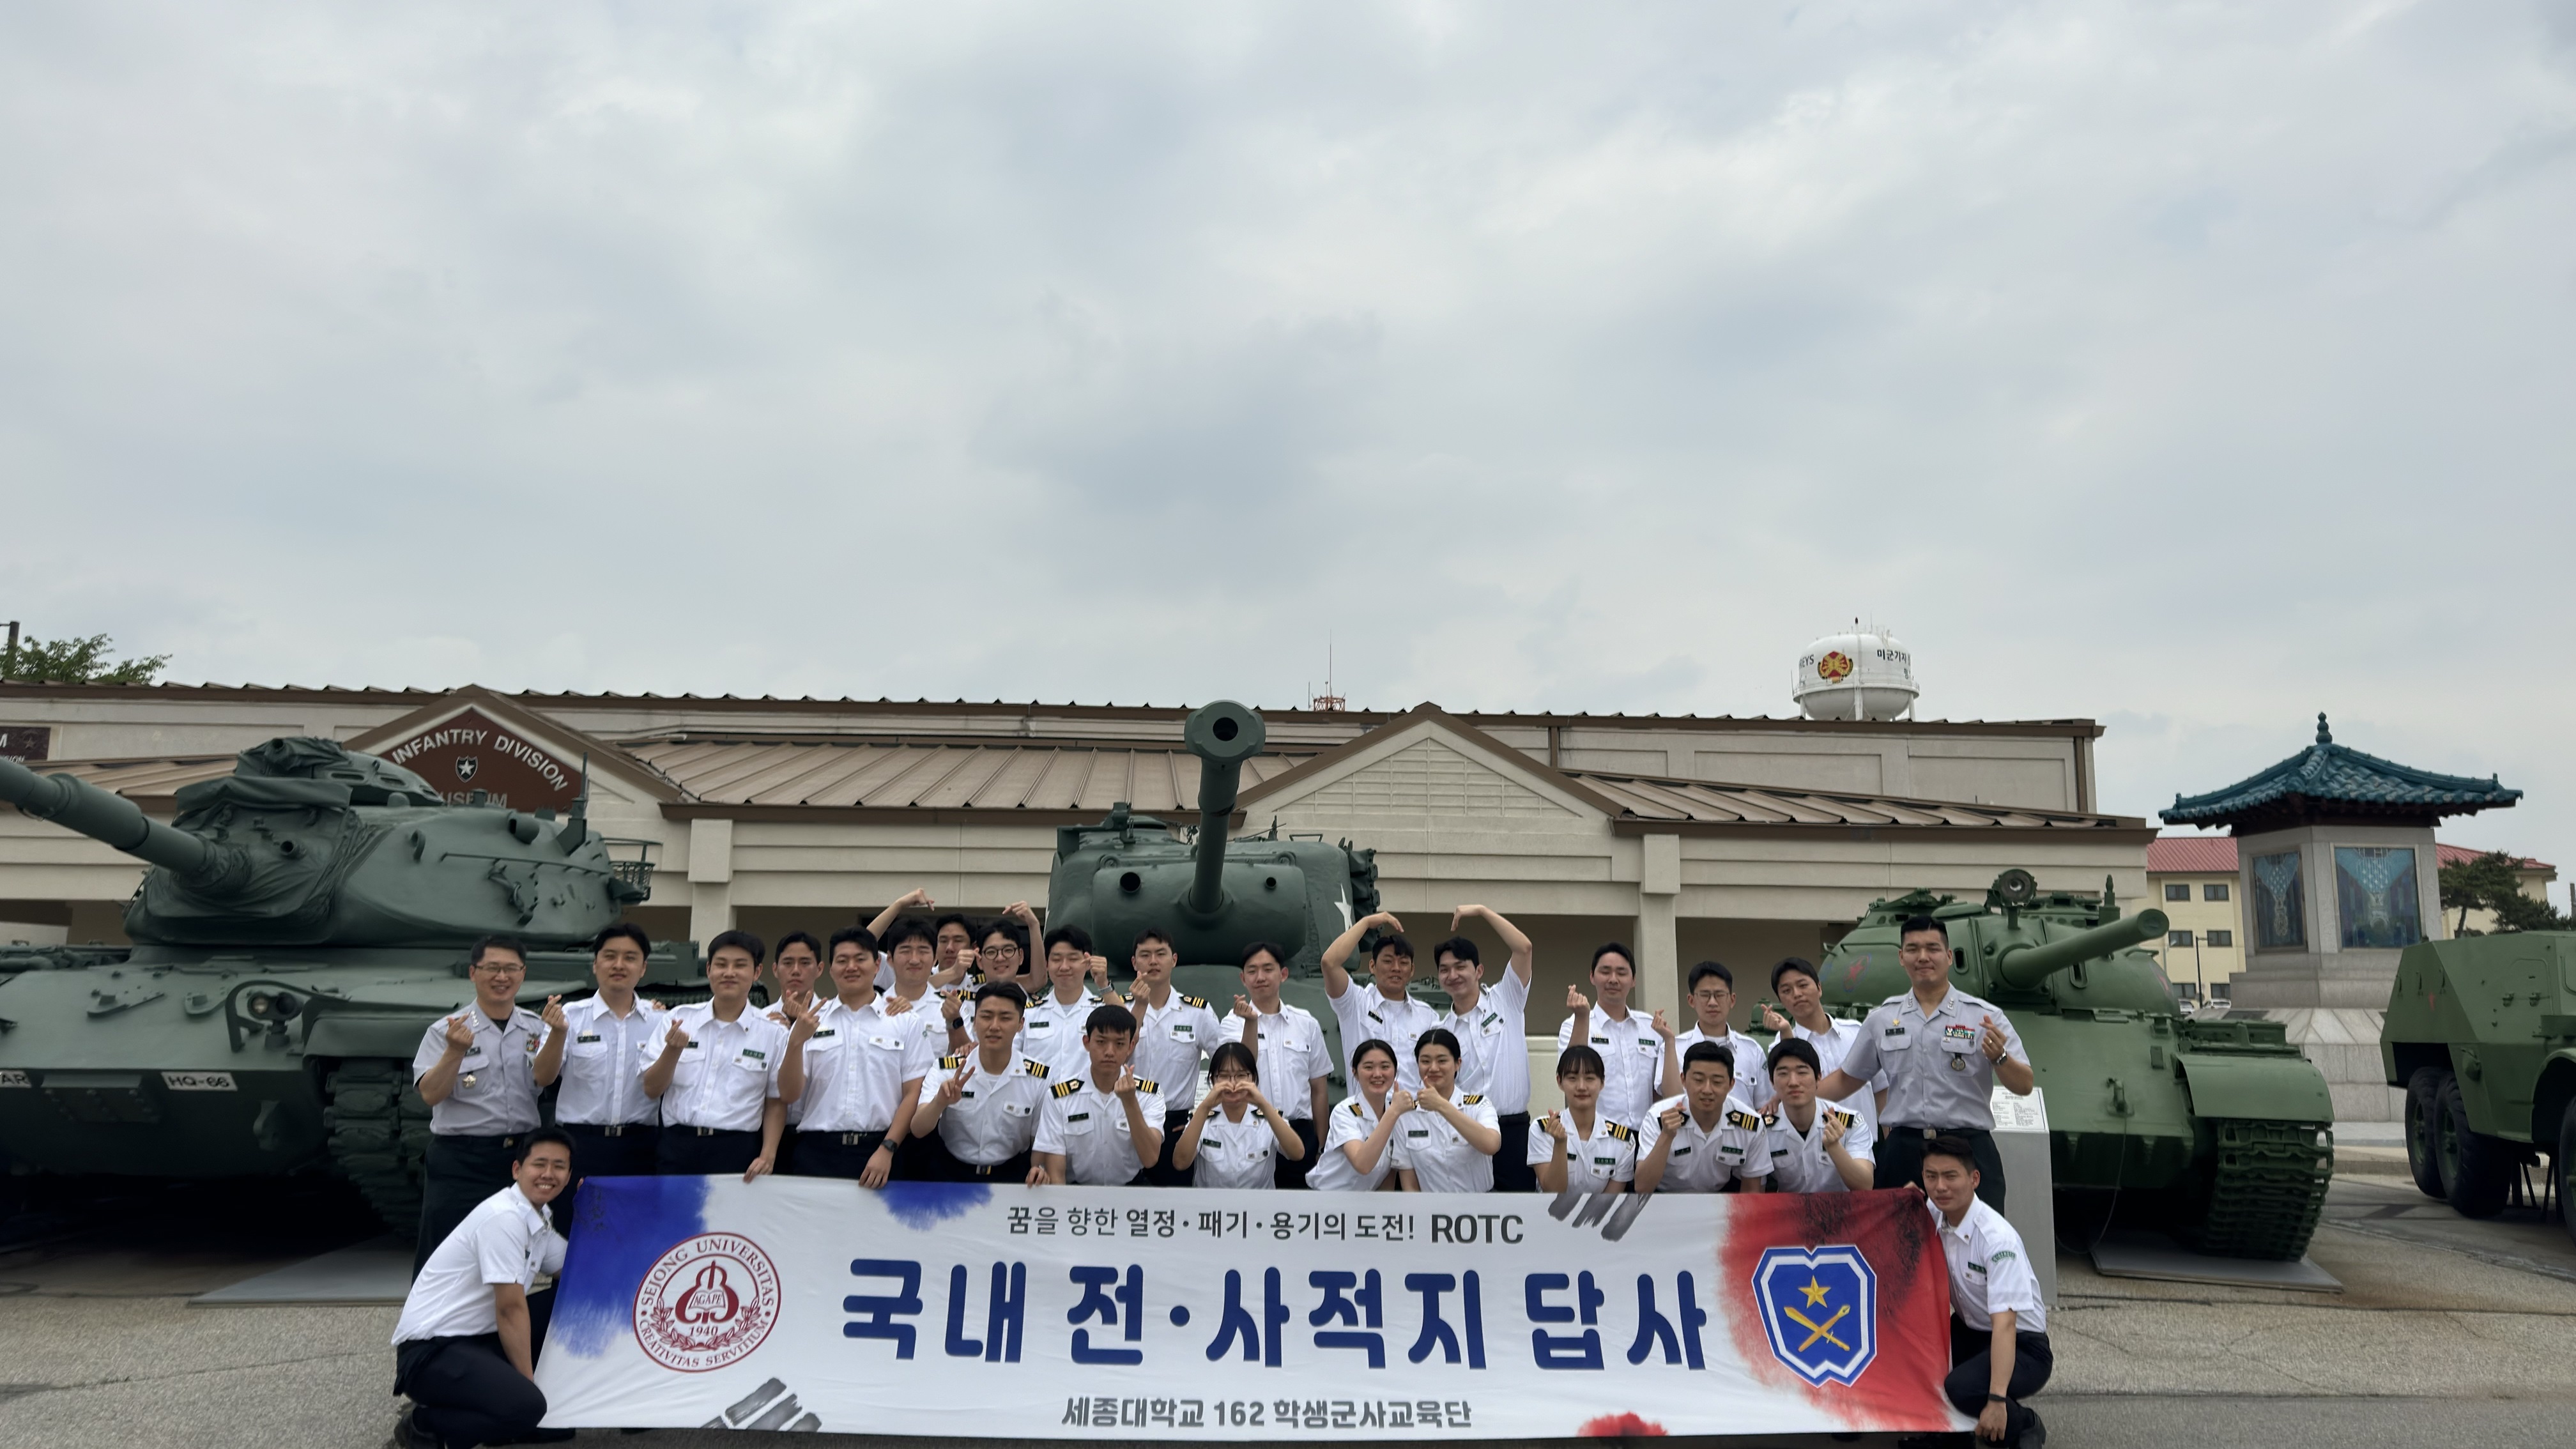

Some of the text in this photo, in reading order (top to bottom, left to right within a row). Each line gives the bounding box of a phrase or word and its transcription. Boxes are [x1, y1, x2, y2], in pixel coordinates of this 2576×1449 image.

[1877, 648, 1907, 664] 미군기지
[392, 728, 569, 792] INFANTRY DIVISION
[1007, 1207, 1059, 1235] 꿈을
[1067, 1207, 1118, 1236] 향한
[1354, 1214, 1414, 1241] 도전!
[1431, 1214, 1524, 1245] ROTC
[641, 1238, 774, 1307] SEJONG UNIVERSITAS
[693, 1292, 721, 1305] AGAPE
[843, 1259, 1027, 1363] 국내
[1524, 1269, 1707, 1370] 답사
[640, 1319, 769, 1367] CREATIVITAS SERVITIUM
[689, 1326, 718, 1337] 1940
[1061, 1397, 1472, 1429] 세종대학교 162 학생군사교육단
